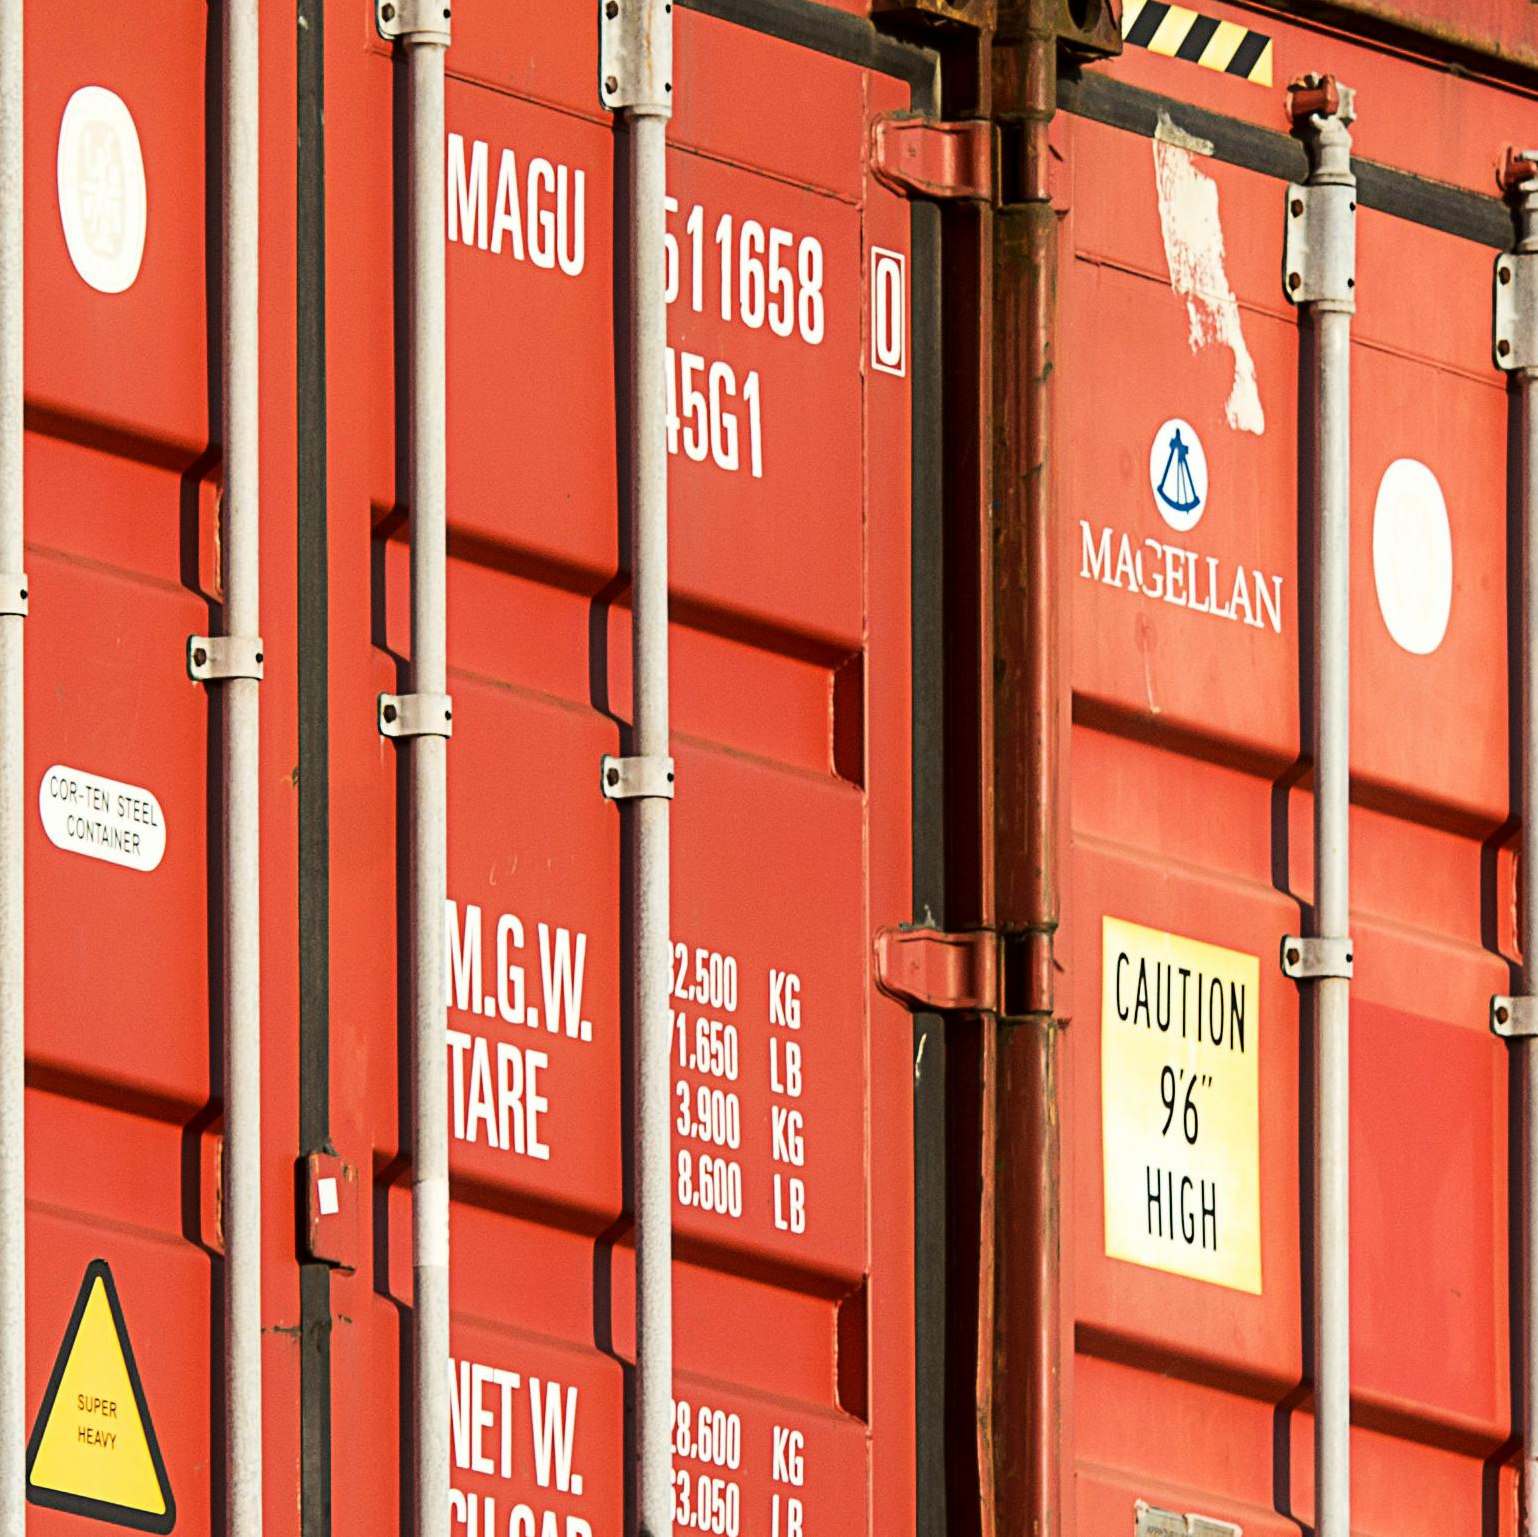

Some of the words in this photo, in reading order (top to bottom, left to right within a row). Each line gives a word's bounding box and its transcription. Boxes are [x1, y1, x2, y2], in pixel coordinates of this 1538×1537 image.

[447, 132, 586, 277] MAGU
[665, 196, 826, 345] 511658
[875, 256, 902, 367] 0
[1079, 519, 1283, 634] MAGELLAN
[49, 775, 111, 813] COR-TEN
[116, 793, 159, 828] STEEL
[66, 814, 142, 857] CONTAINER
[446, 898, 593, 1043] M.G.W.
[768, 968, 802, 1030] KG
[1115, 951, 1246, 1054] CAUTION
[446, 1028, 551, 1161] TARE
[768, 1036, 803, 1098] LB
[771, 1105, 805, 1167] KG
[773, 1173, 806, 1236] LB
[1146, 1164, 1218, 1252] HIGH
[76, 1393, 119, 1421] SUPER
[77, 1425, 118, 1452] HEAVY
[449, 1356, 521, 1480] NET
[528, 1376, 584, 1496] W.
[772, 1425, 805, 1488] KG
